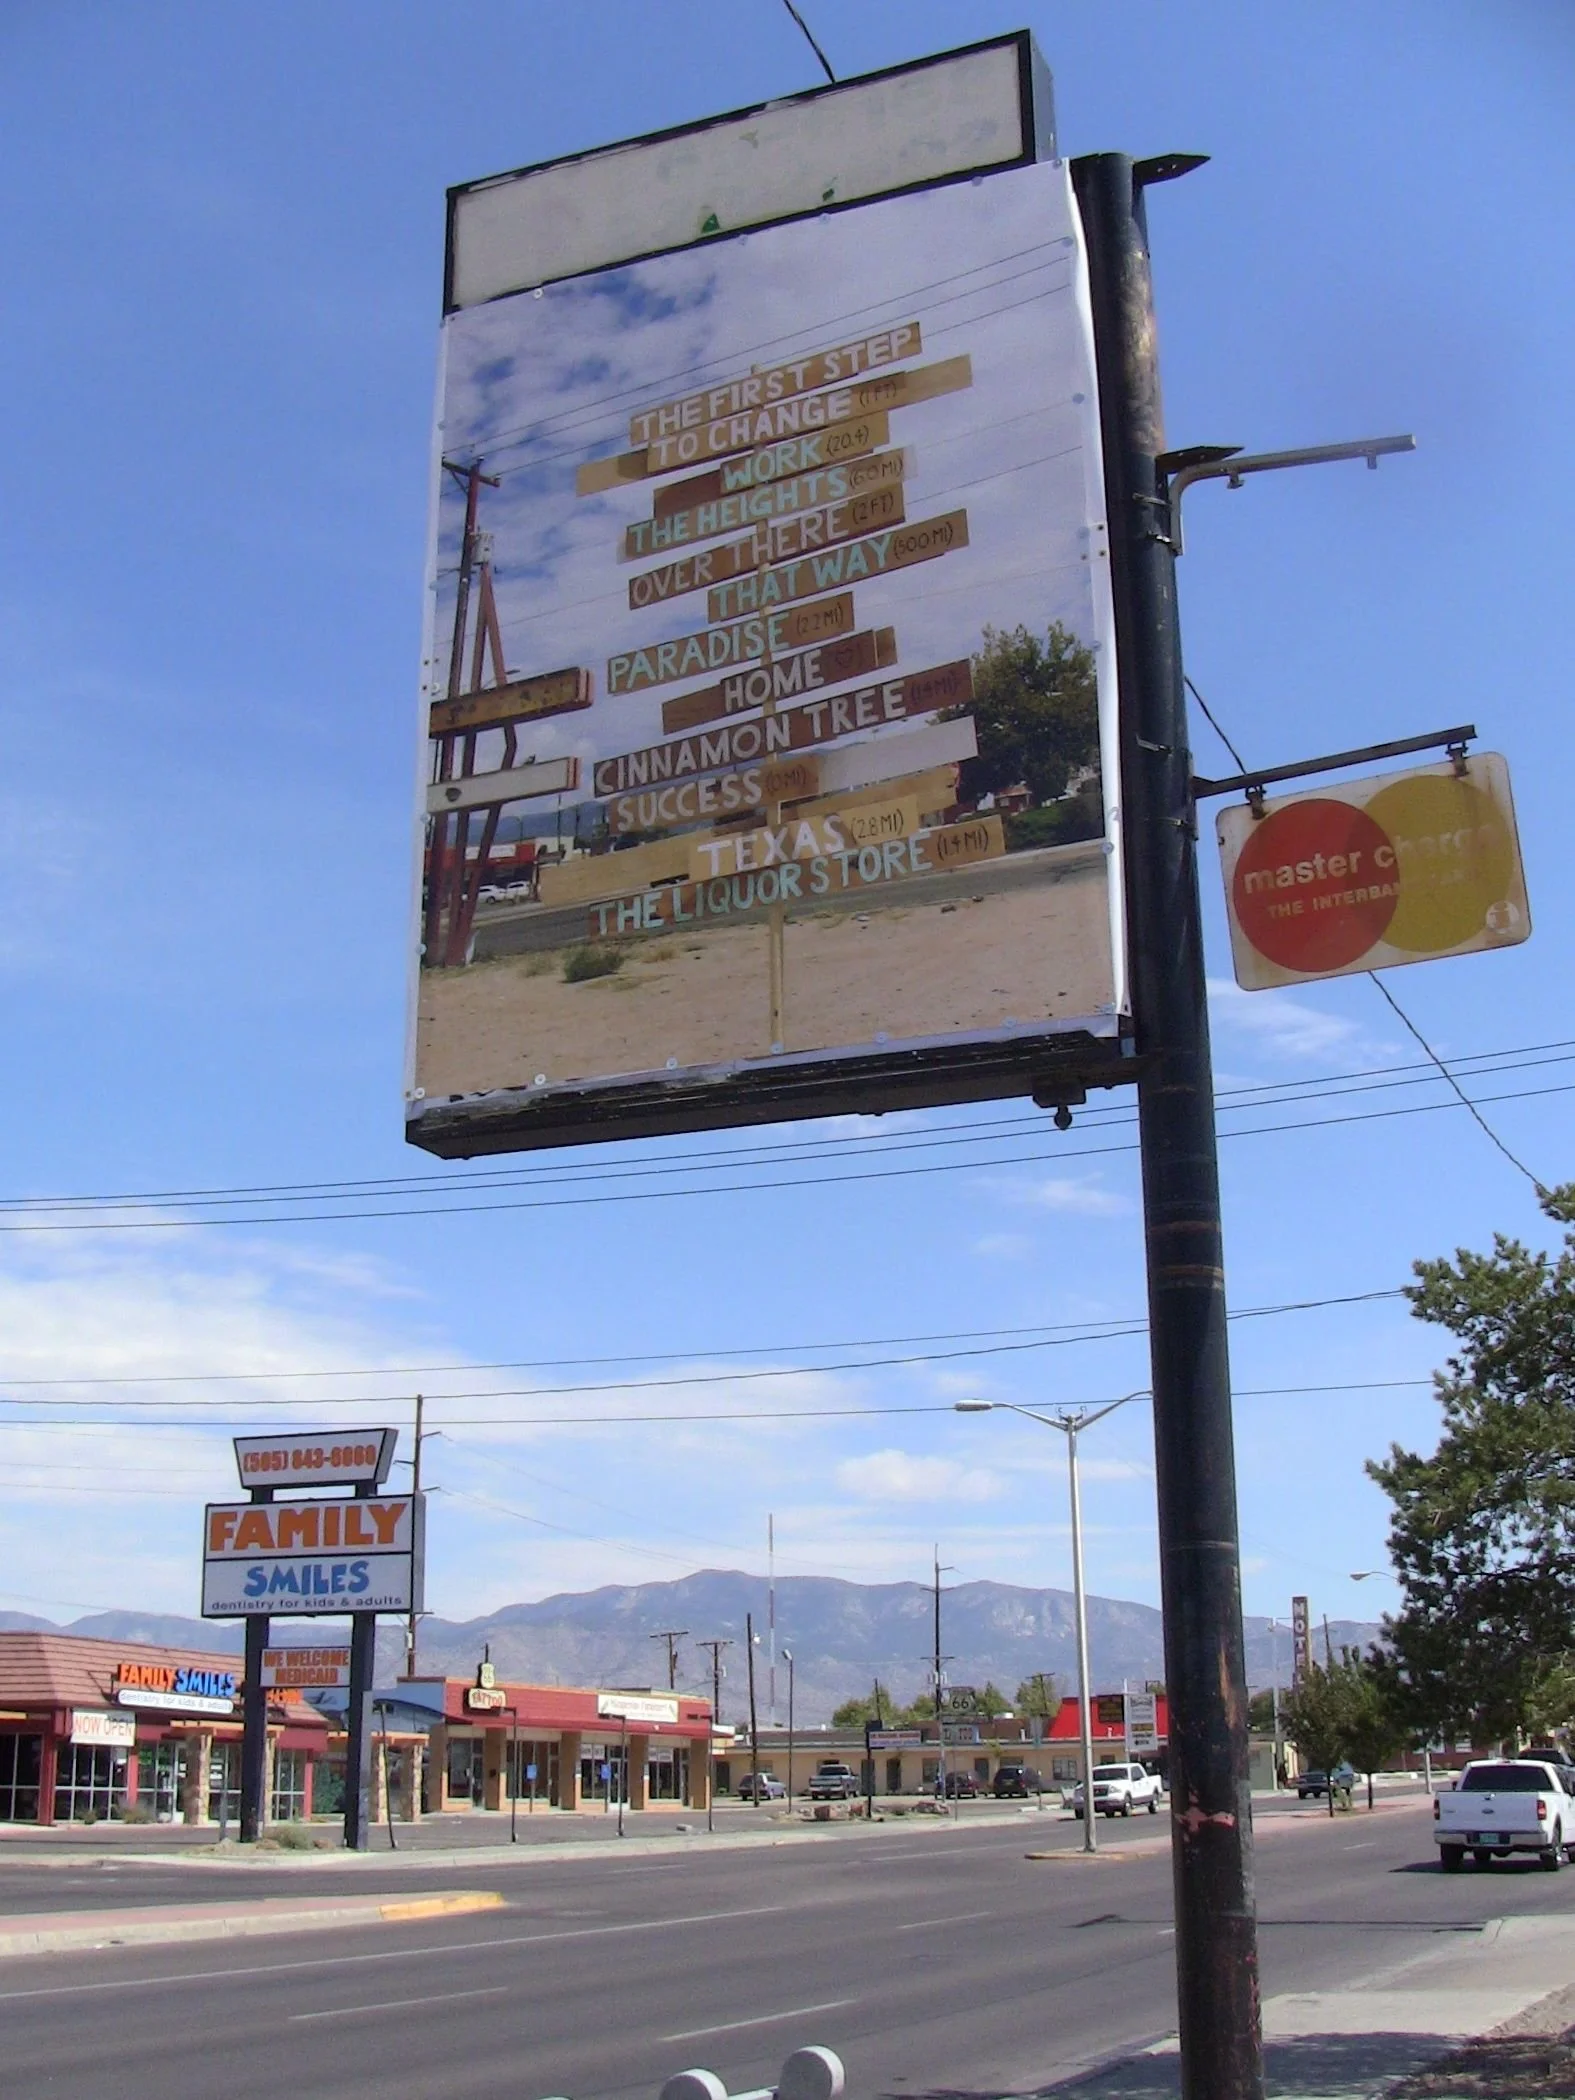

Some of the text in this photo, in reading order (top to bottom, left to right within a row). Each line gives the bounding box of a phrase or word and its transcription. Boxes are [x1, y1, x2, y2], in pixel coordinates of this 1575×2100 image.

[636, 329, 912, 441] THE FIRST STEP
[653, 431, 698, 466] TO
[708, 389, 851, 451] CHANGE
[723, 436, 828, 490] WORK
[632, 511, 690, 553] THE
[700, 466, 849, 535] HEIGHTS
[632, 556, 713, 603] OVER
[726, 501, 849, 564] THERE
[714, 564, 800, 618] THAT
[812, 532, 893, 588] WAY
[610, 611, 790, 692] PARADISE
[725, 649, 825, 713] HOME
[595, 713, 791, 795] CINNAMON
[803, 679, 907, 739] TREE
[617, 768, 763, 832] SUCCESS
[697, 814, 845, 877] TEXAS
[1244, 850, 1362, 894] master
[590, 893, 664, 936] THE
[673, 861, 803, 923] LIQUOR
[810, 830, 933, 895] STORE
[1267, 902, 1305, 919] THE
[209, 1503, 408, 1551] FAMILY
[211, 1596, 402, 1611] dentistry for kids & adults
[244, 1561, 369, 1597] SMILES
[286, 1650, 349, 1666] WELCOME
[1294, 1602, 1306, 1684] MOTEL
[118, 1664, 175, 1688] FAMILY
[175, 1667, 236, 1698] SMILES
[275, 1668, 338, 1684] MEDICAID
[952, 1698, 969, 1710] 66
[75, 1715, 134, 1737] NOW OPEN
